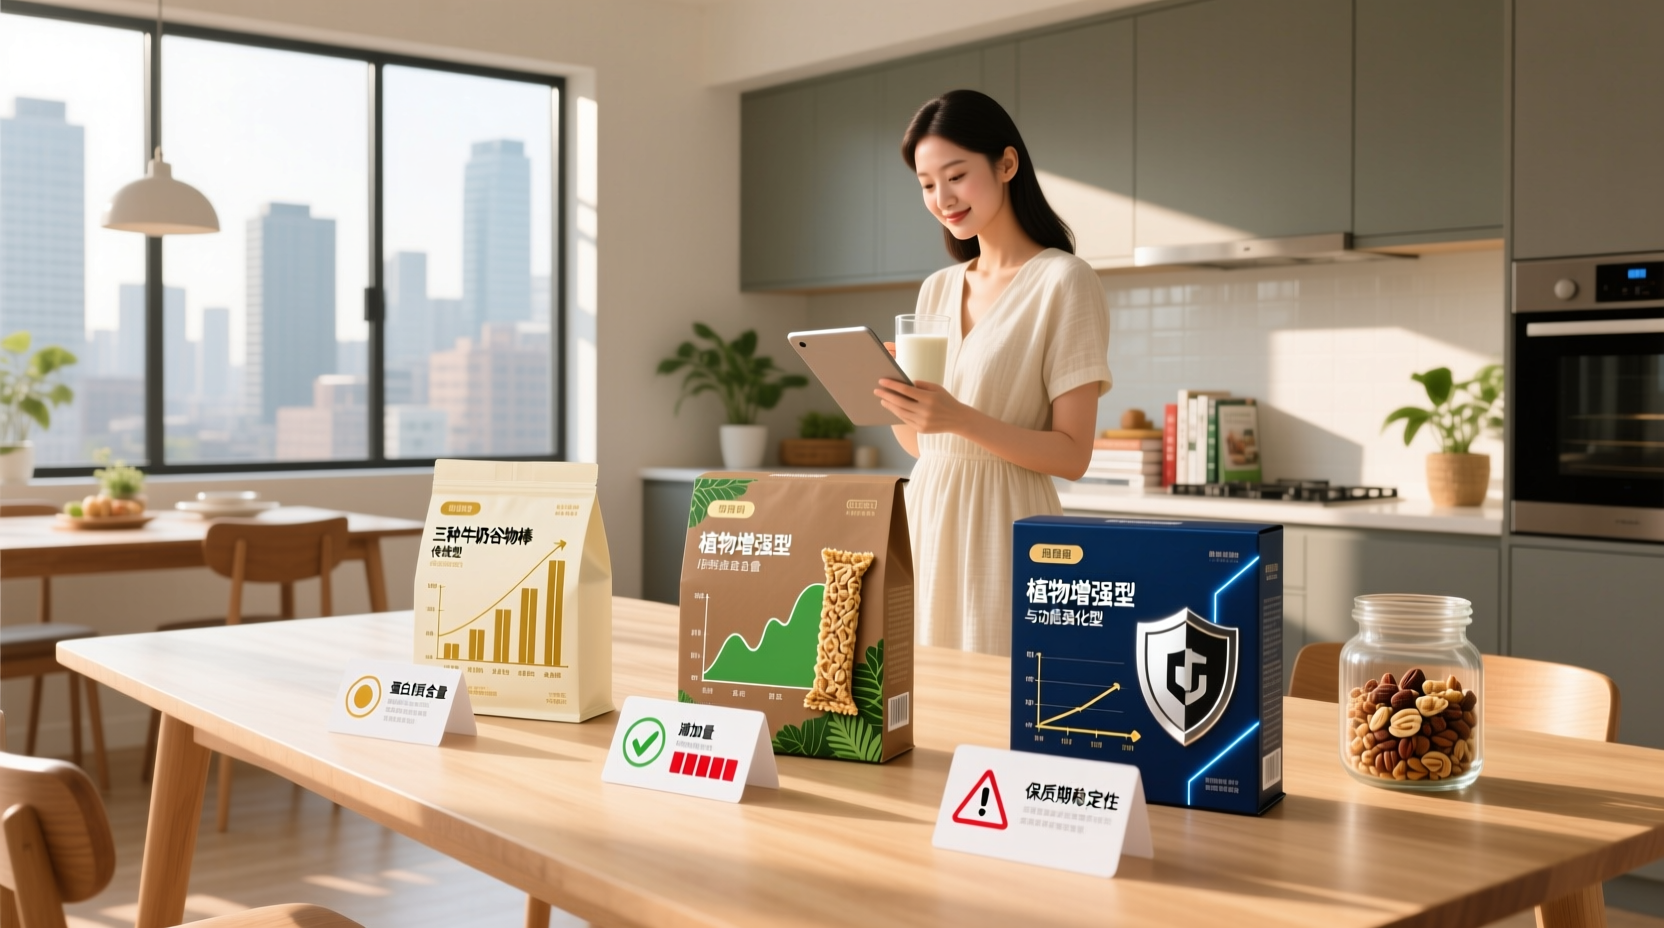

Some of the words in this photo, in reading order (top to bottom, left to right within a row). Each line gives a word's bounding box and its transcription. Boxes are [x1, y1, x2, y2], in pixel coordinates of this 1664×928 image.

[433, 526, 533, 545] 三种牛奶谷物棒
[698, 531, 792, 556] 植物增强型
[1026, 577, 1135, 608] 植物增强型
